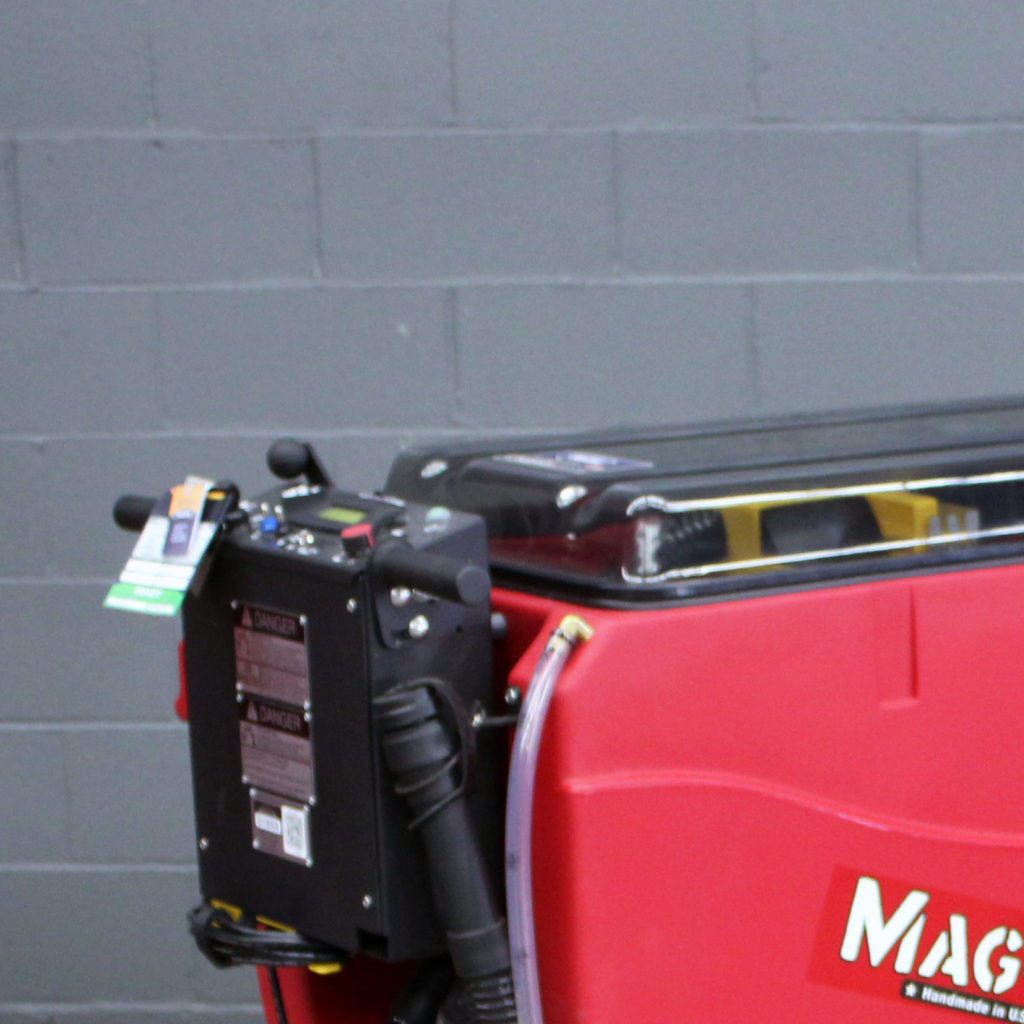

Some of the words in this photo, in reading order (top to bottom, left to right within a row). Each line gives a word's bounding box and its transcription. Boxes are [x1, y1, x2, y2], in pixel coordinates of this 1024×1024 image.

[258, 704, 301, 732] DANGER
[921, 986, 990, 1015] Handmade
[991, 1004, 1006, 1019] in
